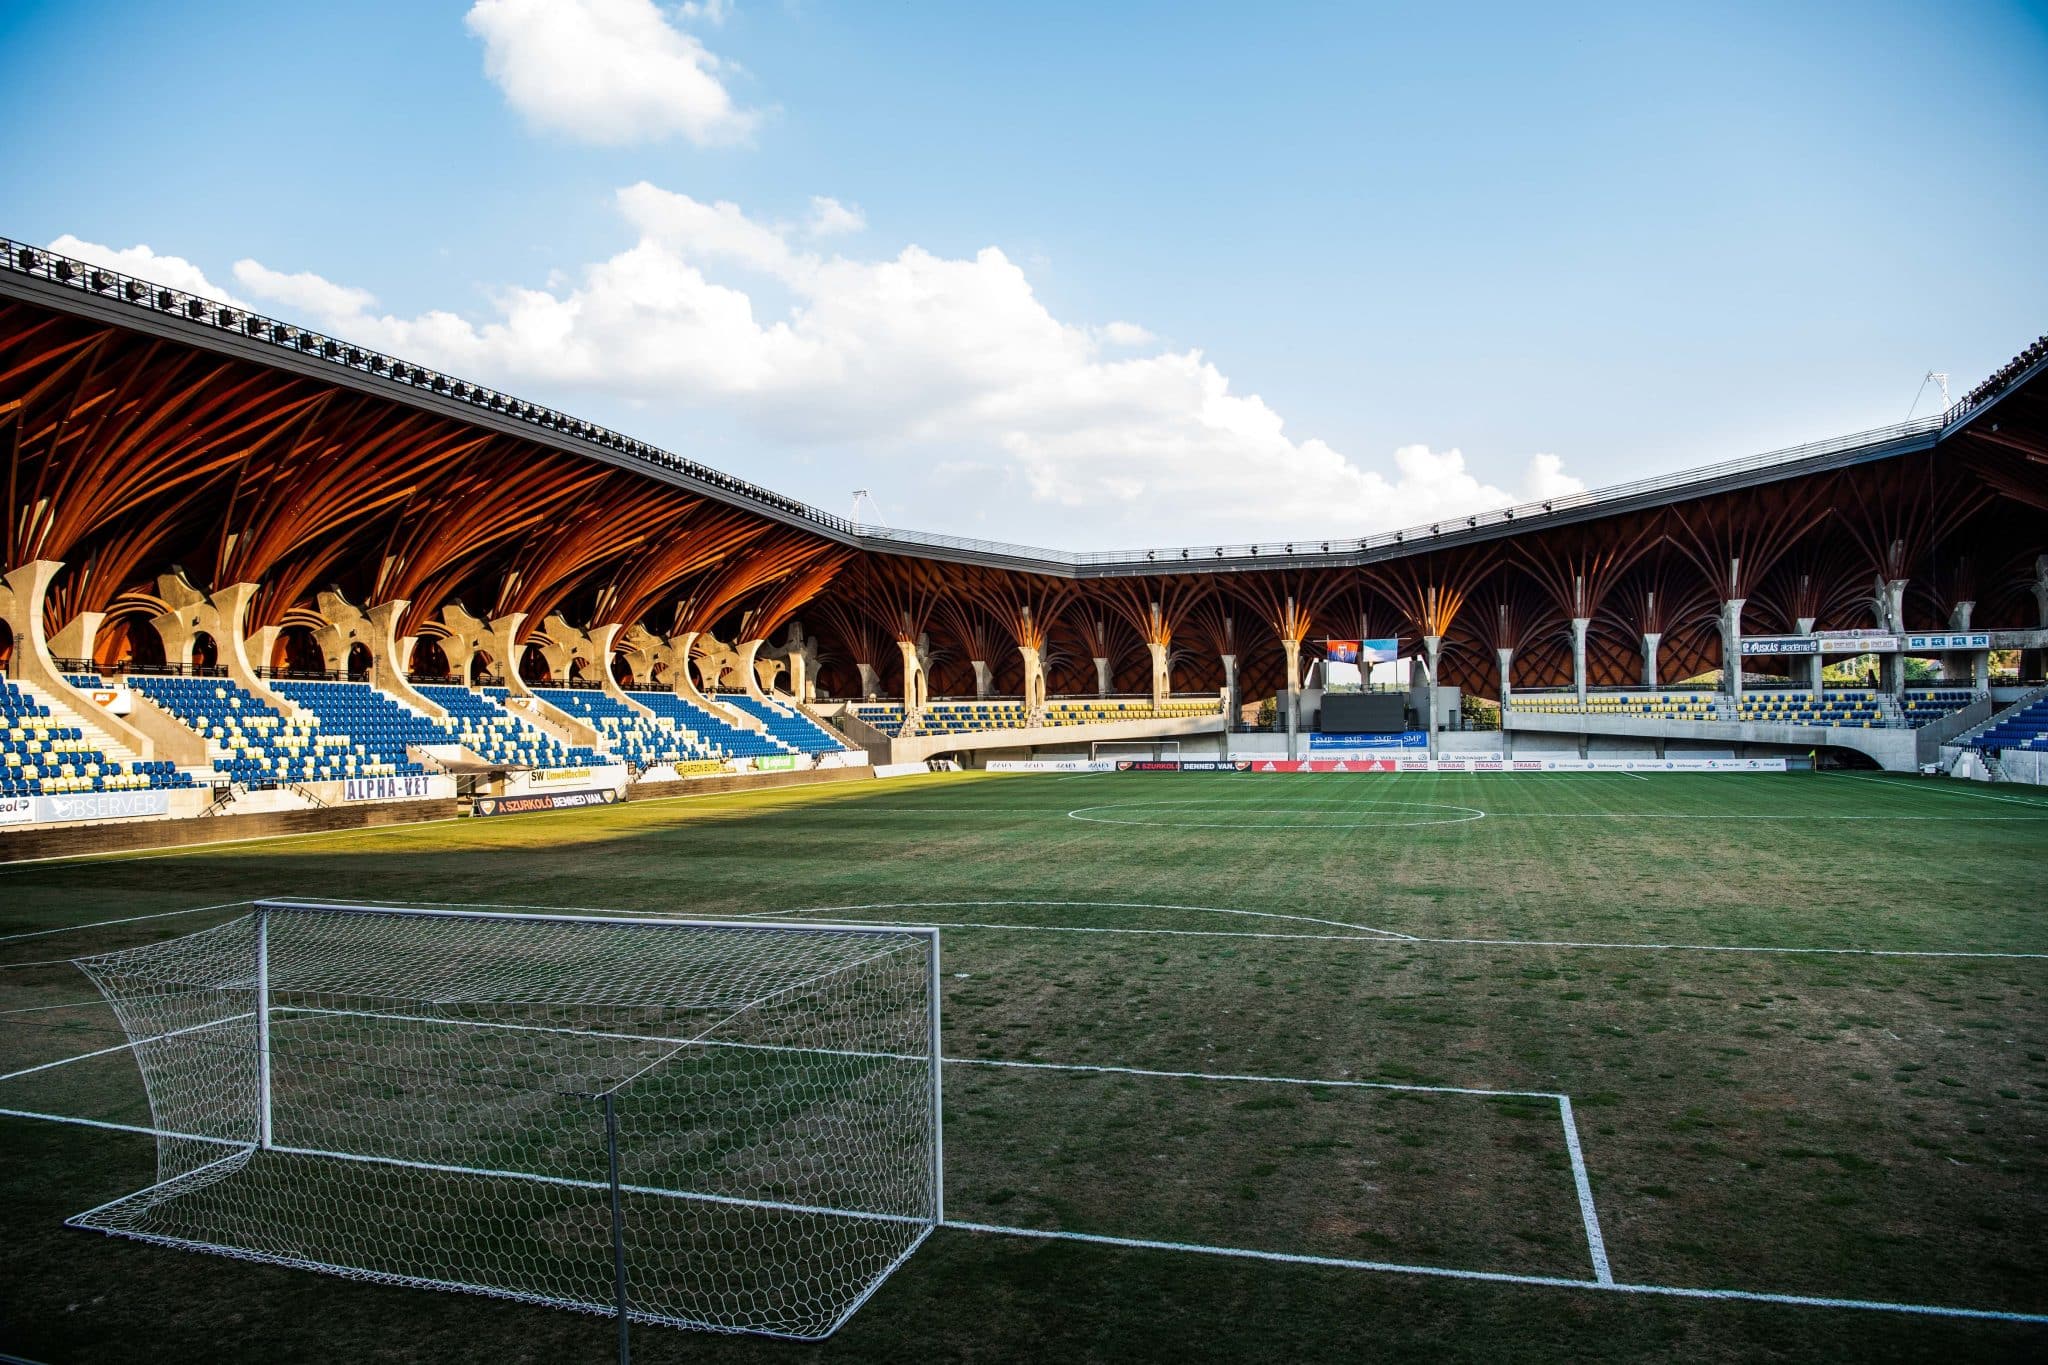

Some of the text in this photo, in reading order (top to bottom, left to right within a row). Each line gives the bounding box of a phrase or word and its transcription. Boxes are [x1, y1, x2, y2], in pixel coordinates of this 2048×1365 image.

[531, 771, 545, 781] SW
[585, 793, 604, 803] VAN.
[57, 795, 156, 818] OBSERVER
